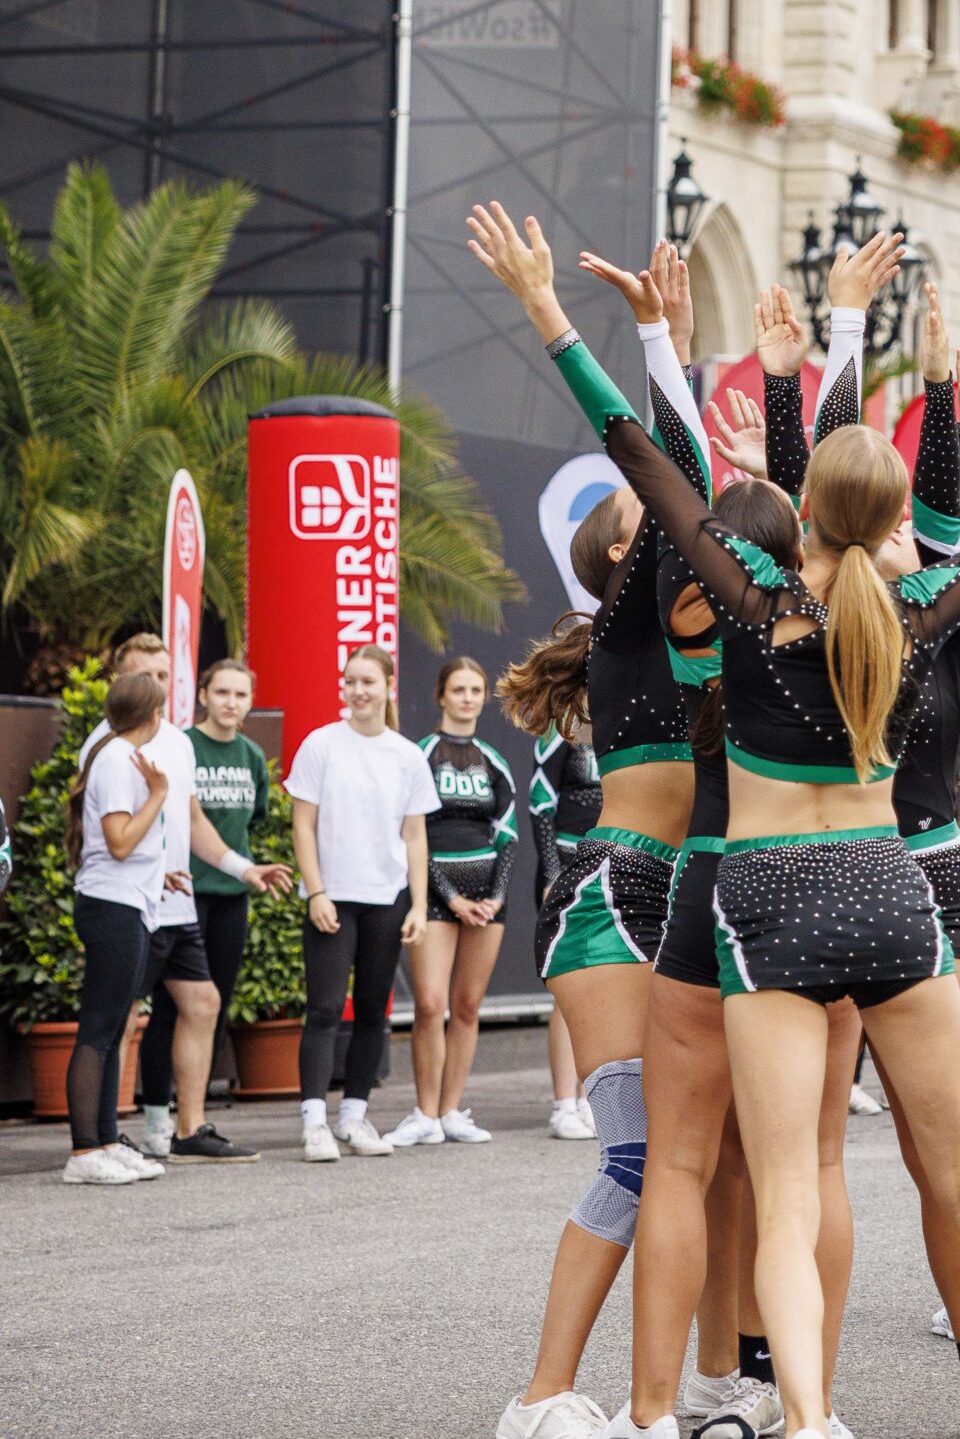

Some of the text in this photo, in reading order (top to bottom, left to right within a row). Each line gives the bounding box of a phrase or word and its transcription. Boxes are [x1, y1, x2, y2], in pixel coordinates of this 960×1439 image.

[373, 455, 399, 651] DTISCHE
[196, 766, 256, 802] RAGONS
[439, 769, 490, 797] DDC
